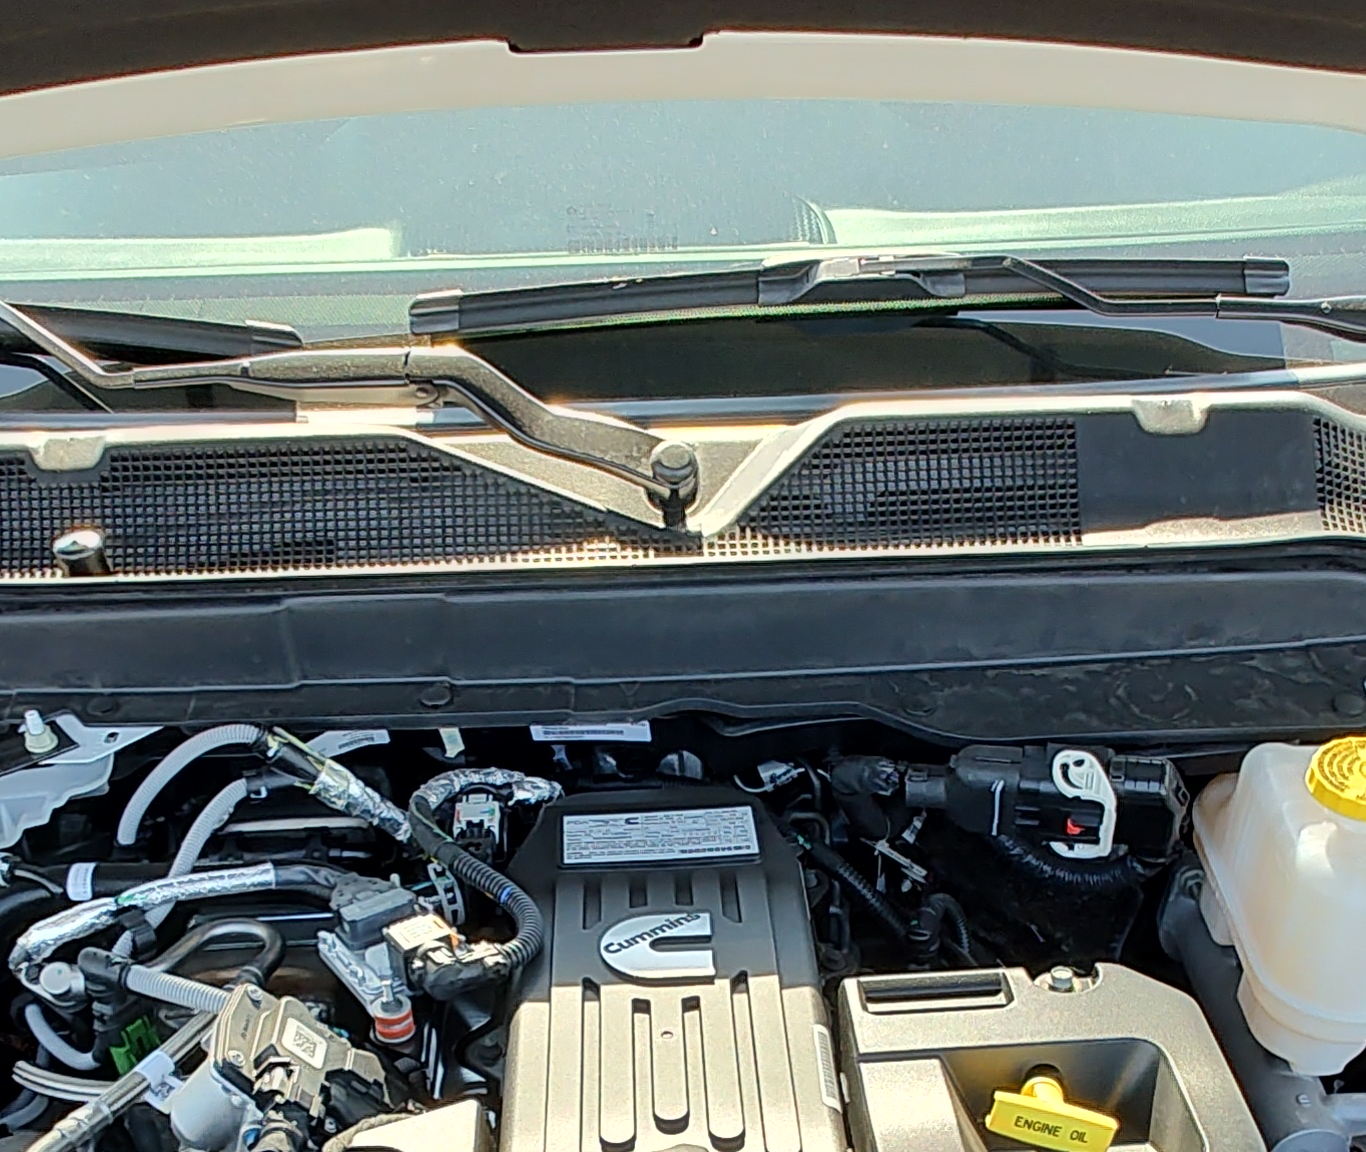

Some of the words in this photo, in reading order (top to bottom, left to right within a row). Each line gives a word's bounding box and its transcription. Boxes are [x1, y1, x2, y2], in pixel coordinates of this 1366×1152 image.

[603, 913, 701, 954] Cummins
[1014, 1115, 1062, 1137] ENGINE
[1069, 1130, 1089, 1144] OIL
